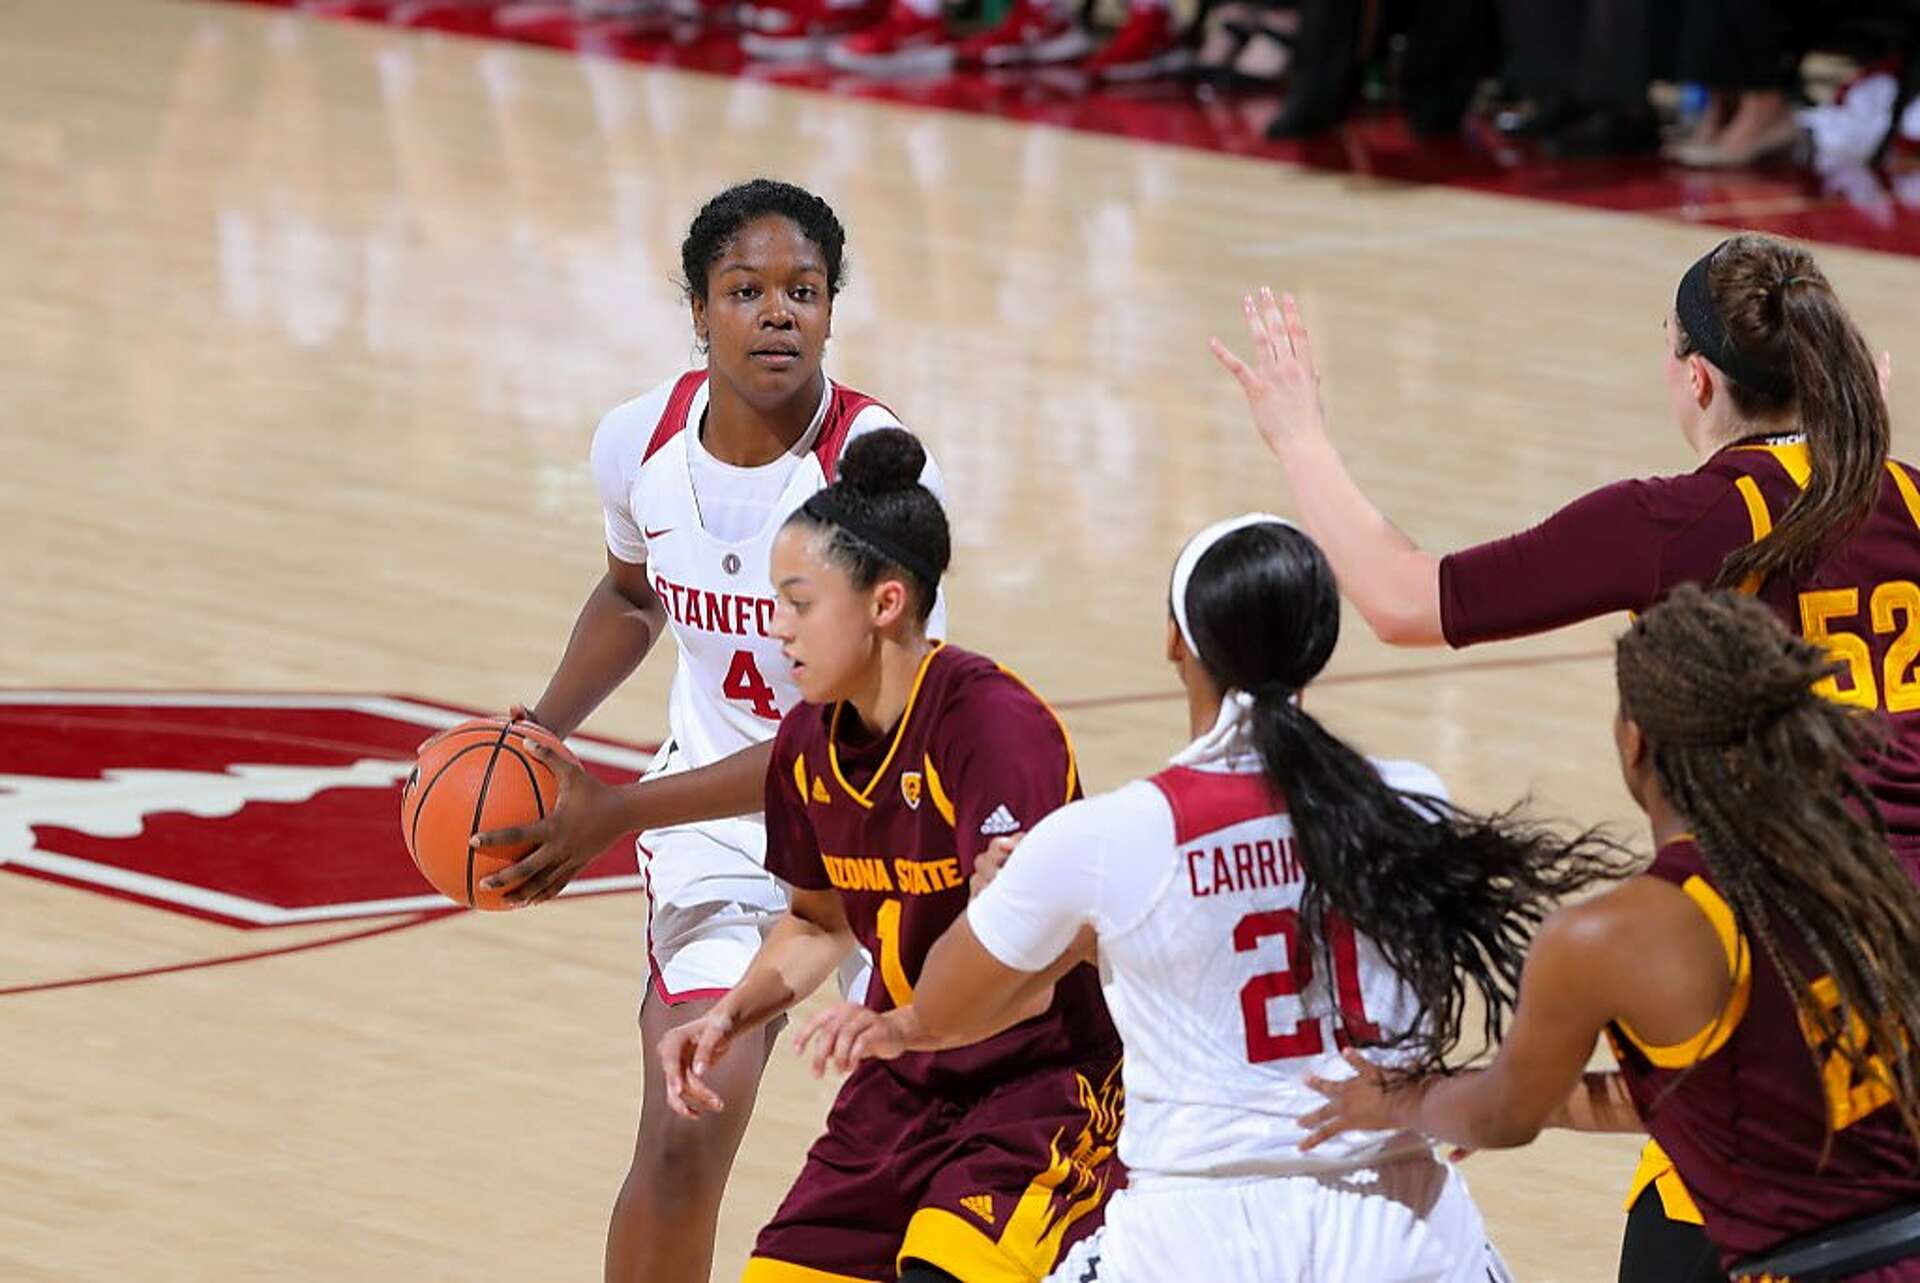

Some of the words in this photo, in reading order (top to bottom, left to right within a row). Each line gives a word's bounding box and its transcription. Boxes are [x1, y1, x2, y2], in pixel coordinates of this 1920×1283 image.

[722, 650, 782, 720] 4
[1798, 580, 1920, 713] 52
[821, 855, 893, 891] IZONA
[894, 857, 963, 894] STATE
[877, 899, 914, 1008] 1
[1233, 905, 1381, 1064] 21
